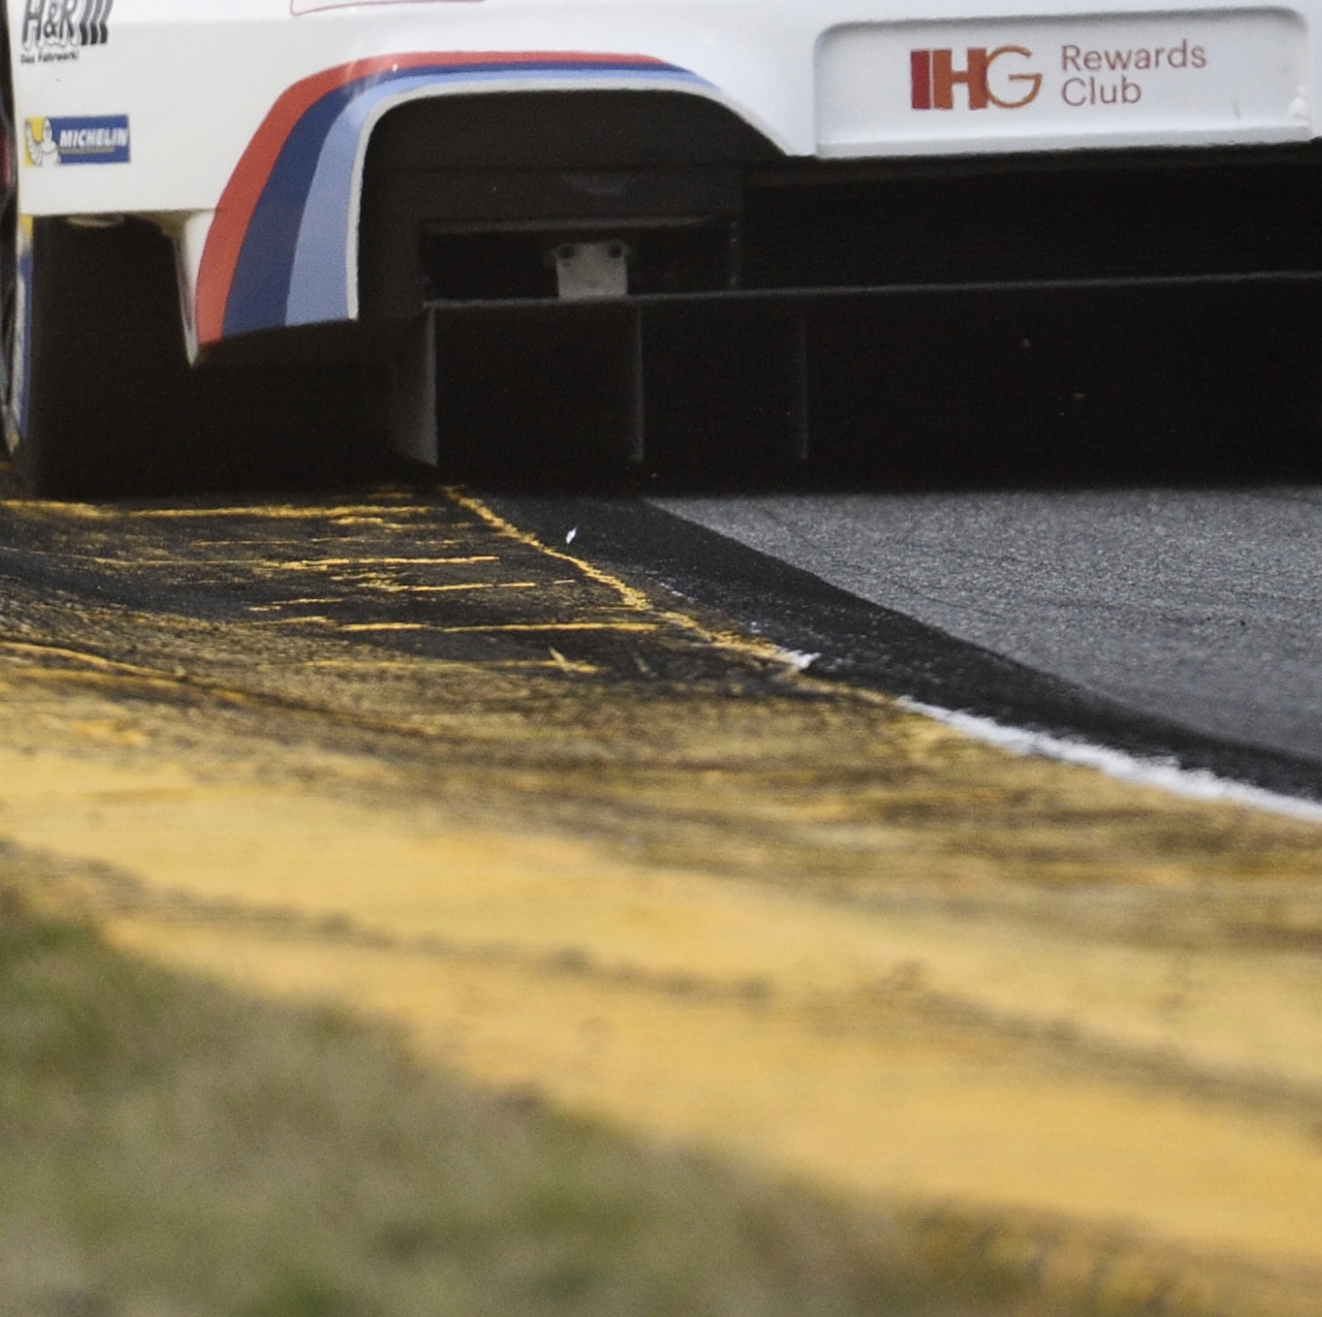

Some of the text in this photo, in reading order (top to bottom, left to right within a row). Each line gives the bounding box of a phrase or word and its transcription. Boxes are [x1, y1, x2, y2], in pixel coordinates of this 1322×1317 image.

[910, 39, 1207, 111] IHG Rewards
[1061, 77, 1142, 107] Club
[59, 128, 128, 148] MICHELIN
